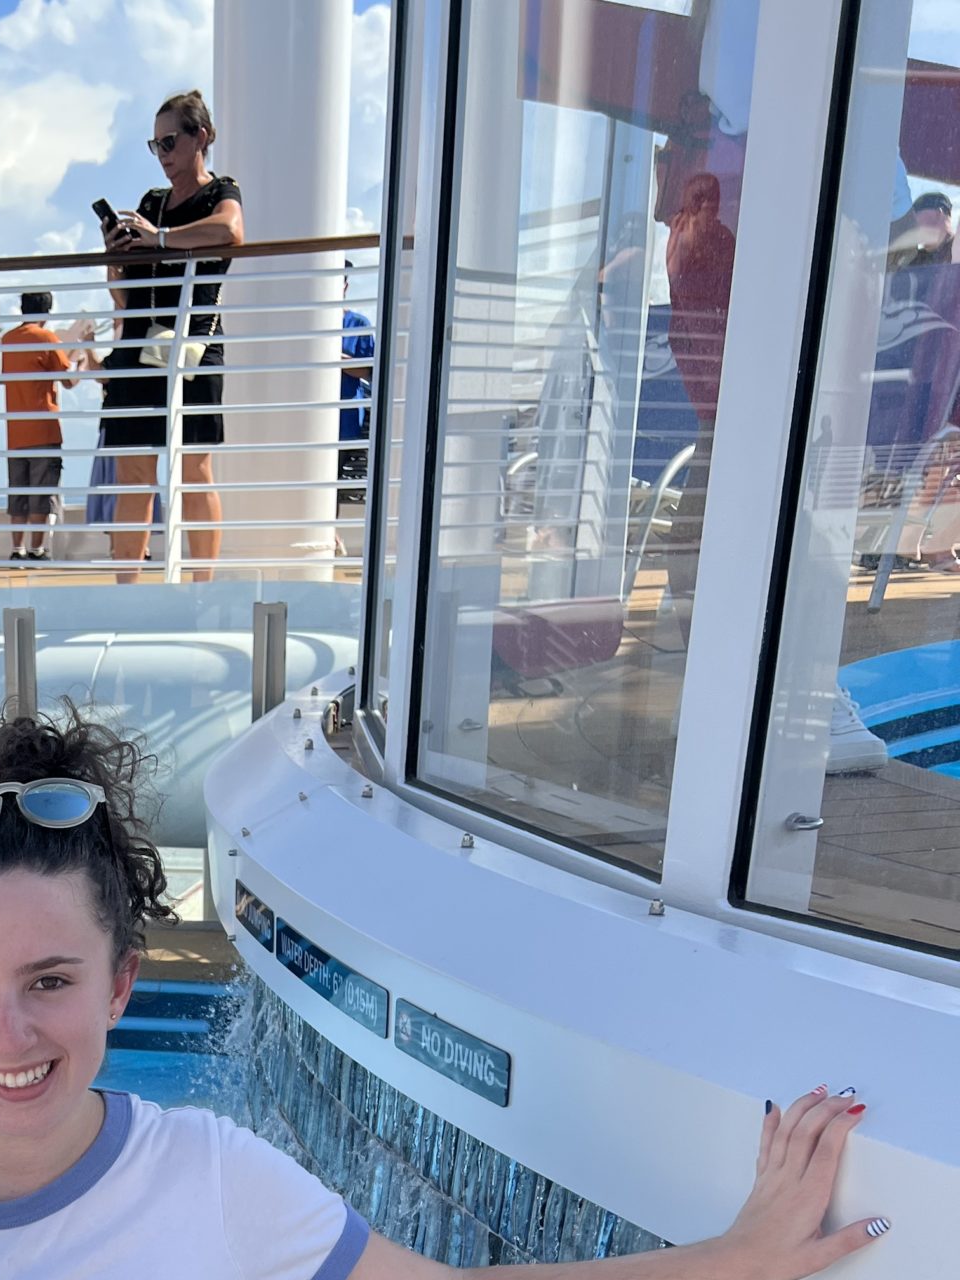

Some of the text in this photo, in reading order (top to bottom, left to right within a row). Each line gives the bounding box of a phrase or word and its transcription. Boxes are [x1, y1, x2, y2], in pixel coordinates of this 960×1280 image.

[281, 932, 303, 970] WATER
[304, 951, 331, 989] DEPTH:
[421, 1025, 495, 1086] NO DIVING
